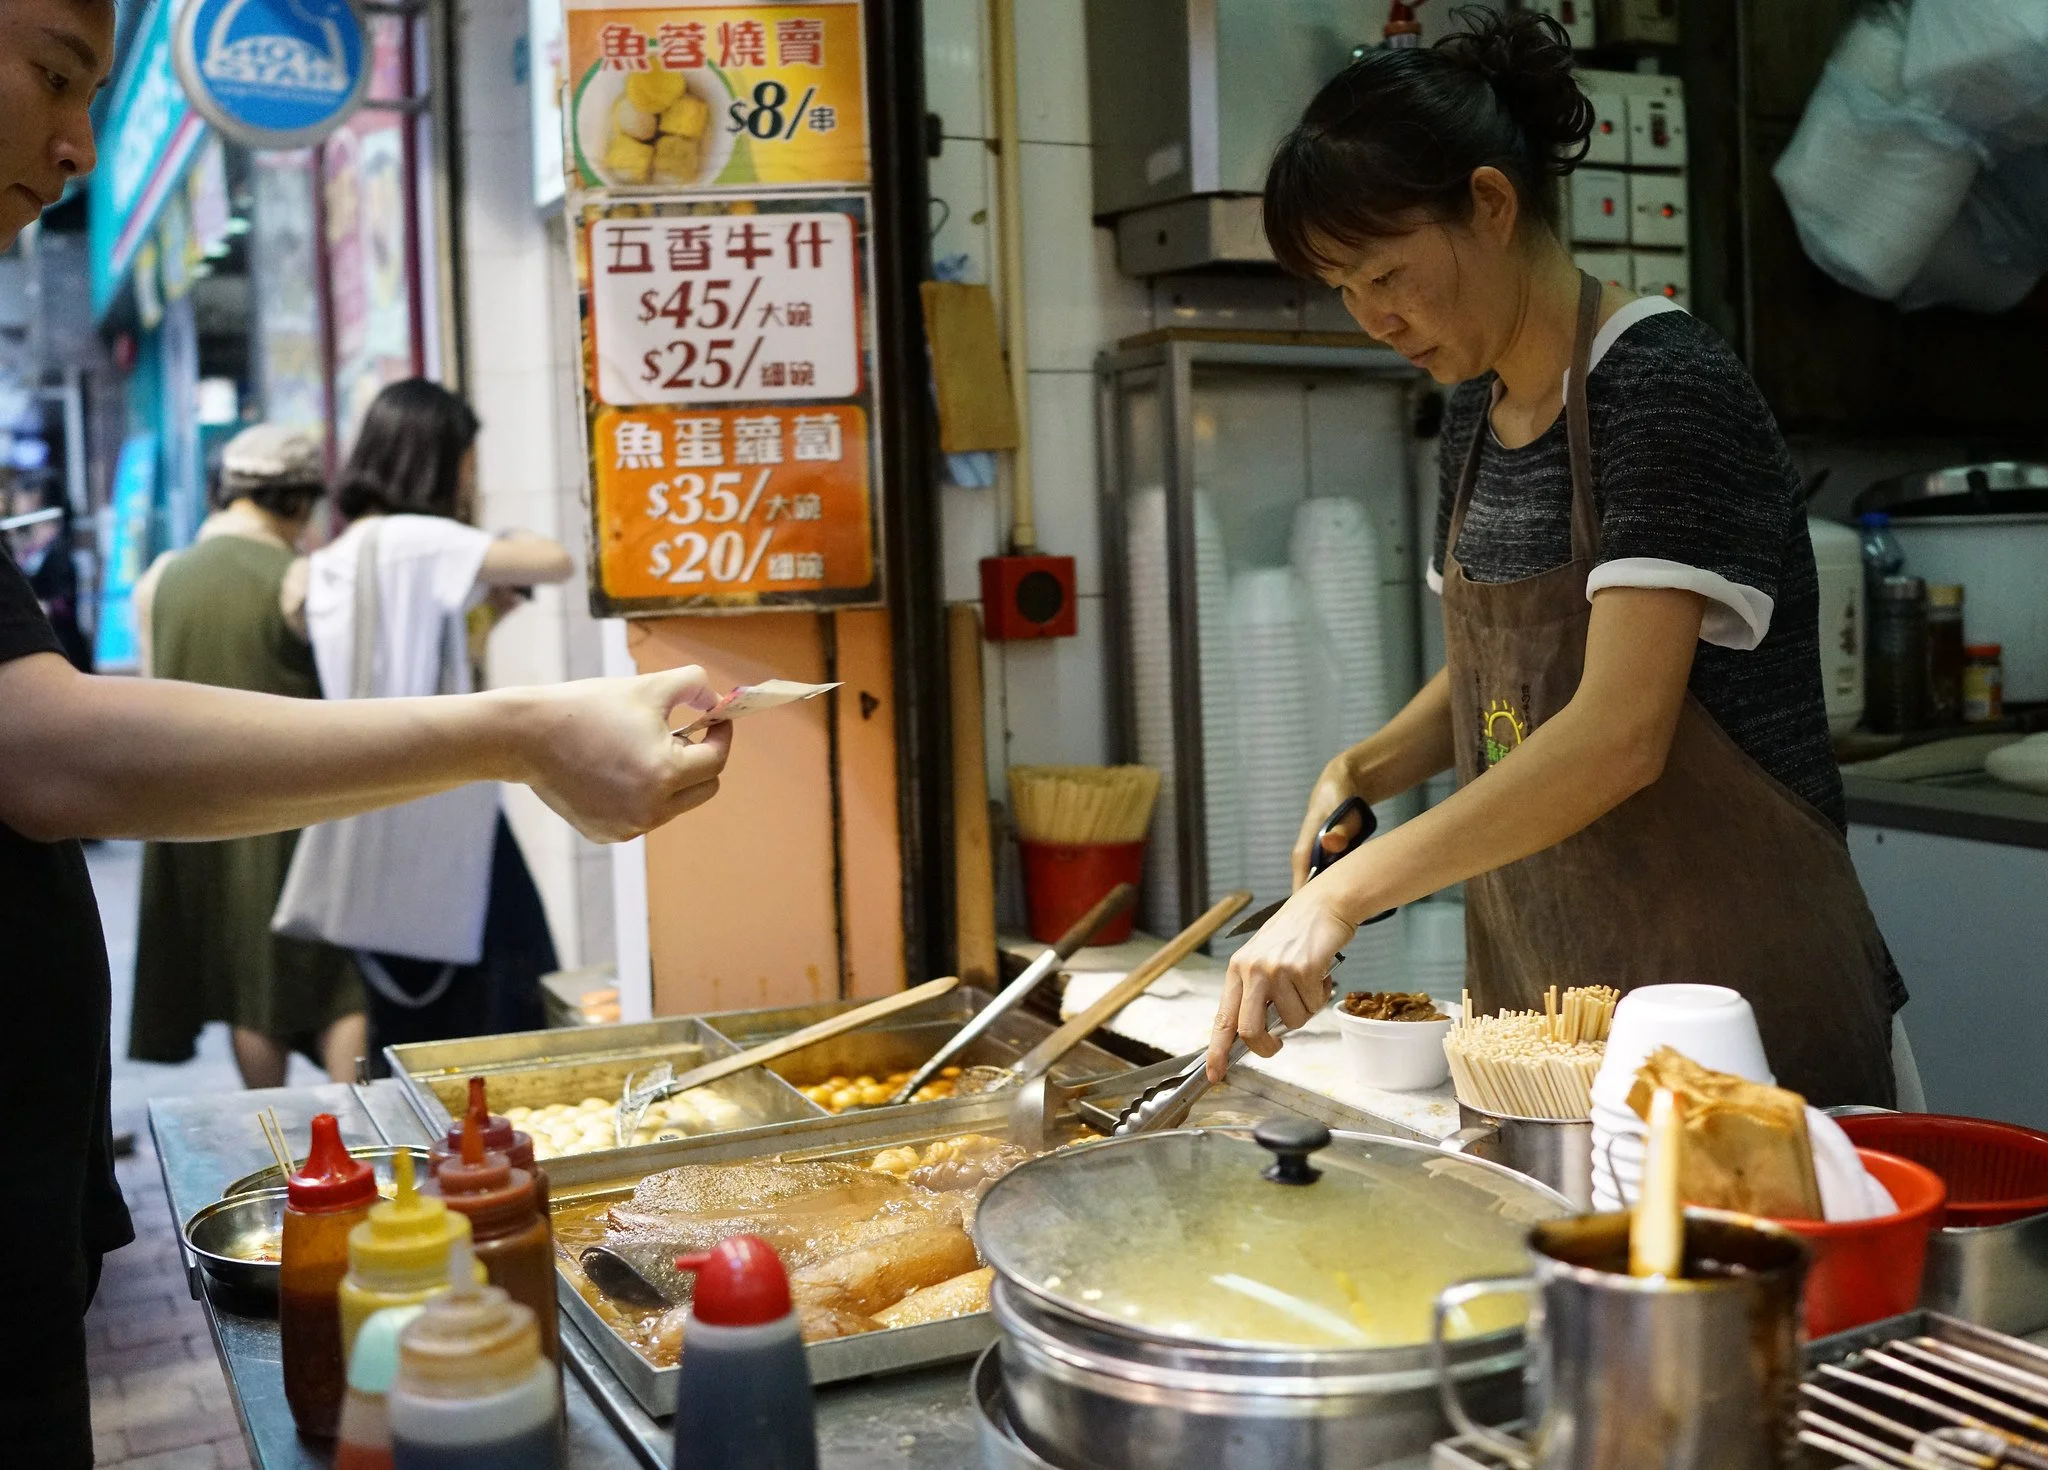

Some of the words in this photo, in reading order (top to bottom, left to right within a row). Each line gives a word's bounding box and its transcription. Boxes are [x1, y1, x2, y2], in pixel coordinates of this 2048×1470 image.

[601, 19, 824, 71] 魚蓉燒賣
[727, 81, 836, 140] $8/串
[606, 221, 832, 274] 五香牛什
[614, 413, 843, 470] 魚蛋蘿蔔
